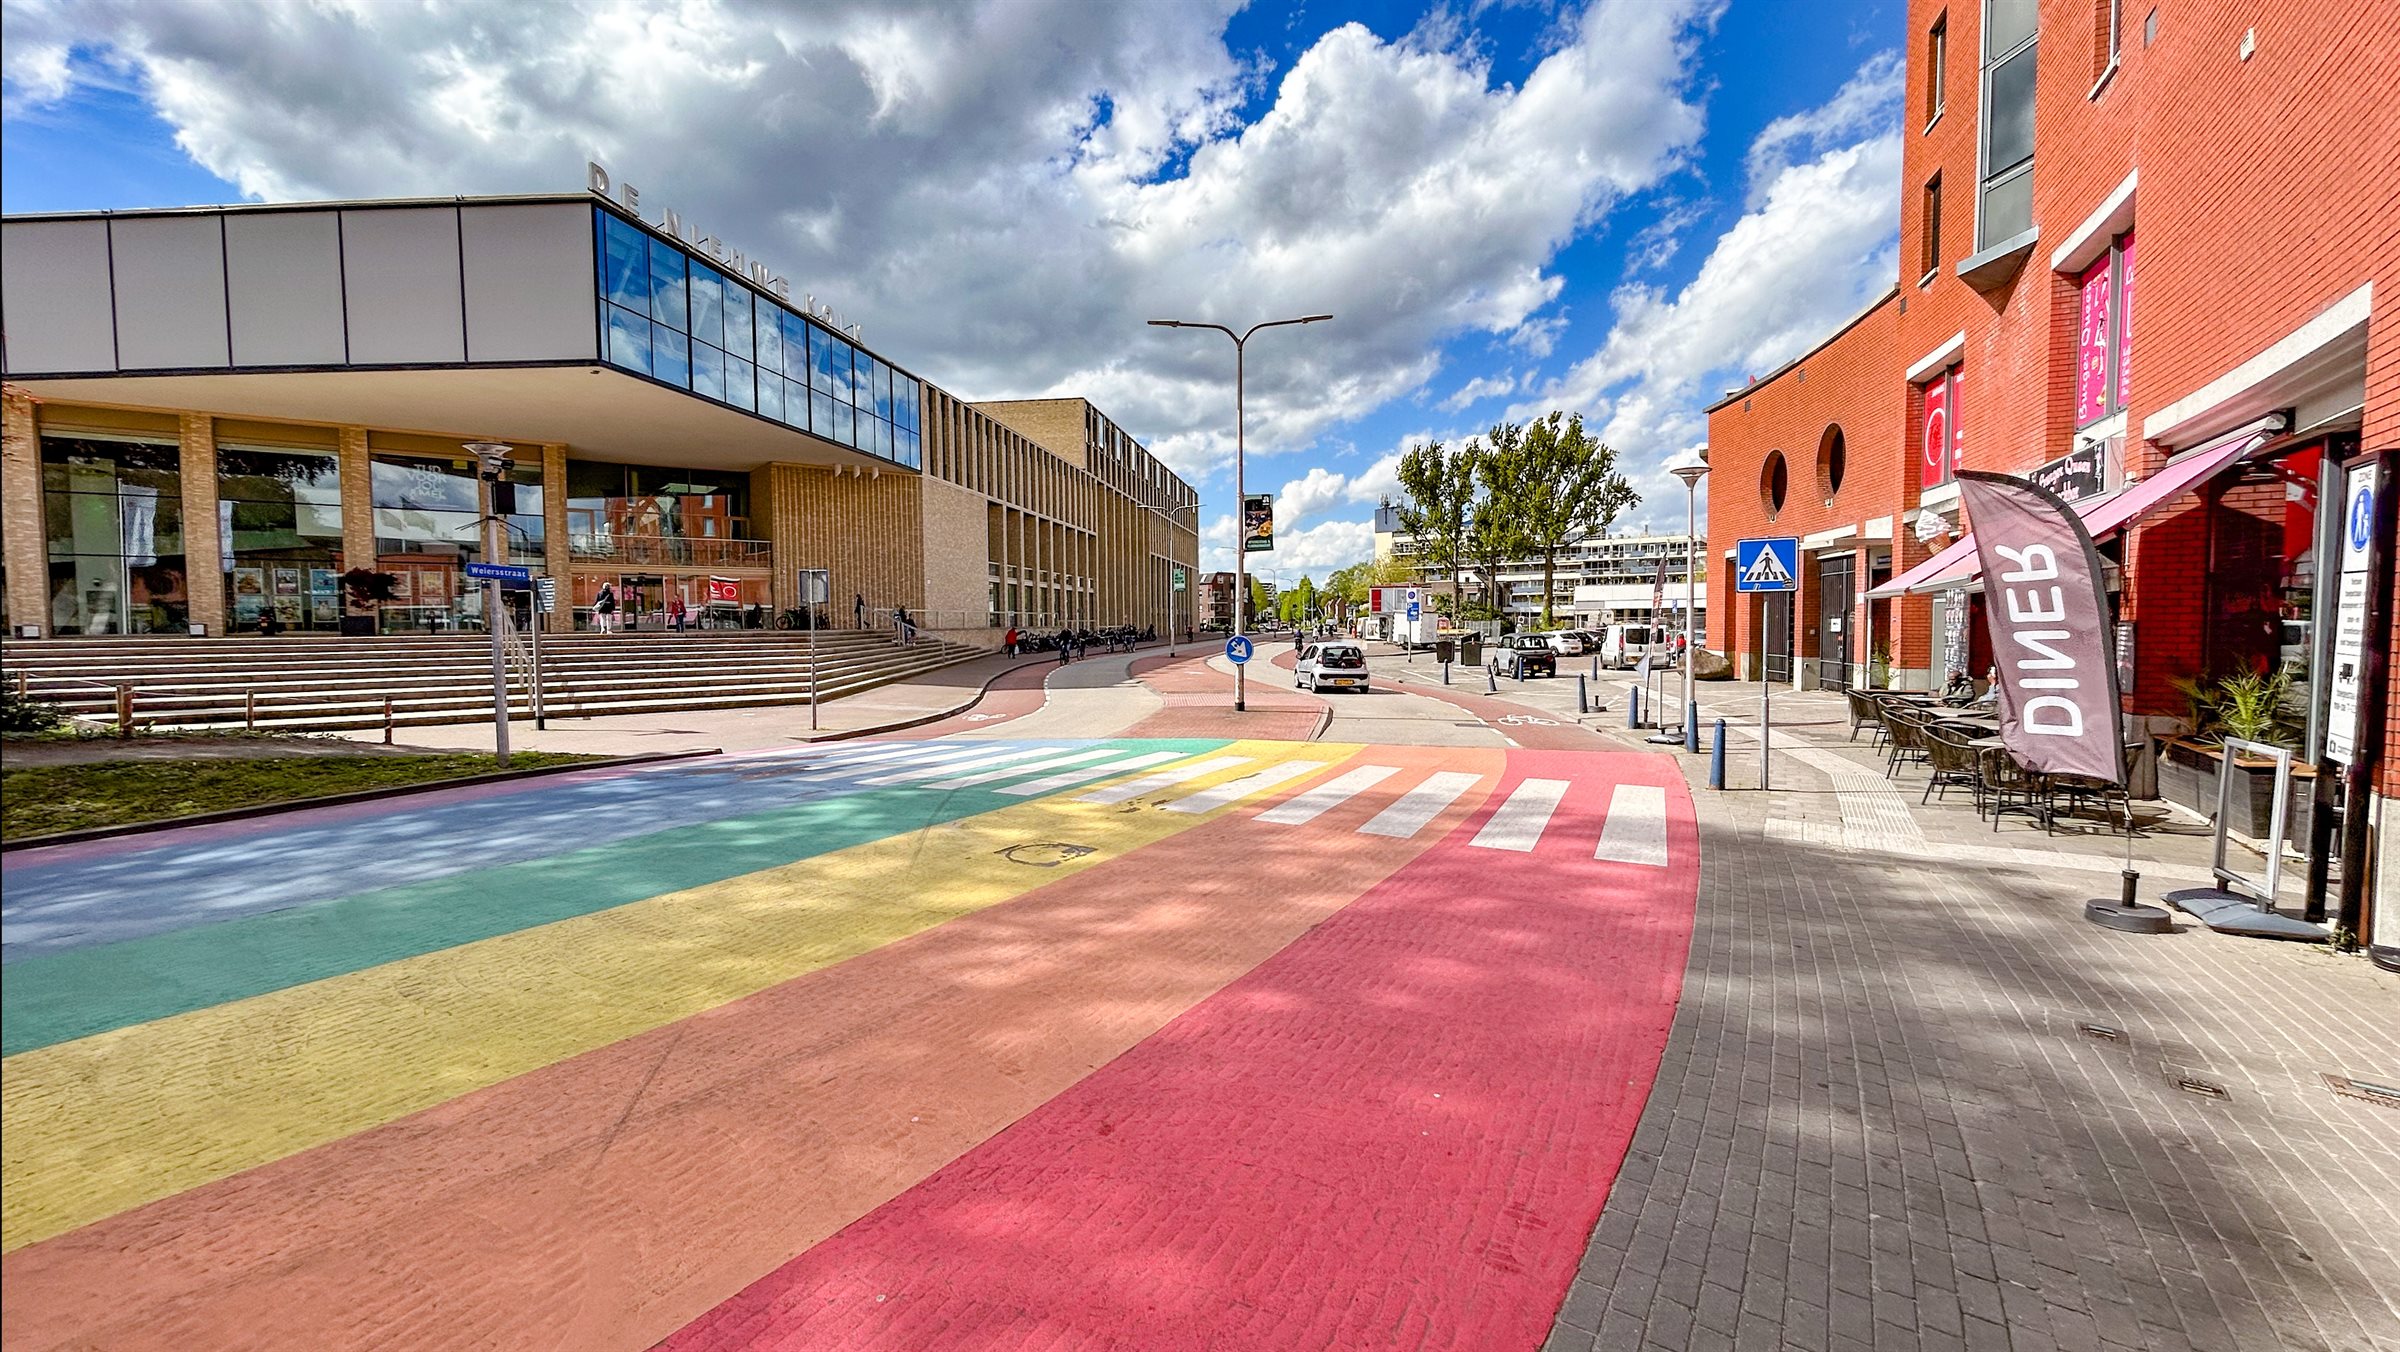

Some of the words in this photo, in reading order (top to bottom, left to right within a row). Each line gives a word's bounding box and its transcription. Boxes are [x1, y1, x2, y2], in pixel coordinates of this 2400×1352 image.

[589, 161, 640, 217] DE
[663, 207, 790, 302] NIEUWE
[803, 292, 864, 346] KOLK
[2081, 279, 2093, 347] Queen
[2078, 351, 2091, 420] Burger
[407, 471, 448, 484] VOOR
[471, 566, 527, 578] Weiersstraat
